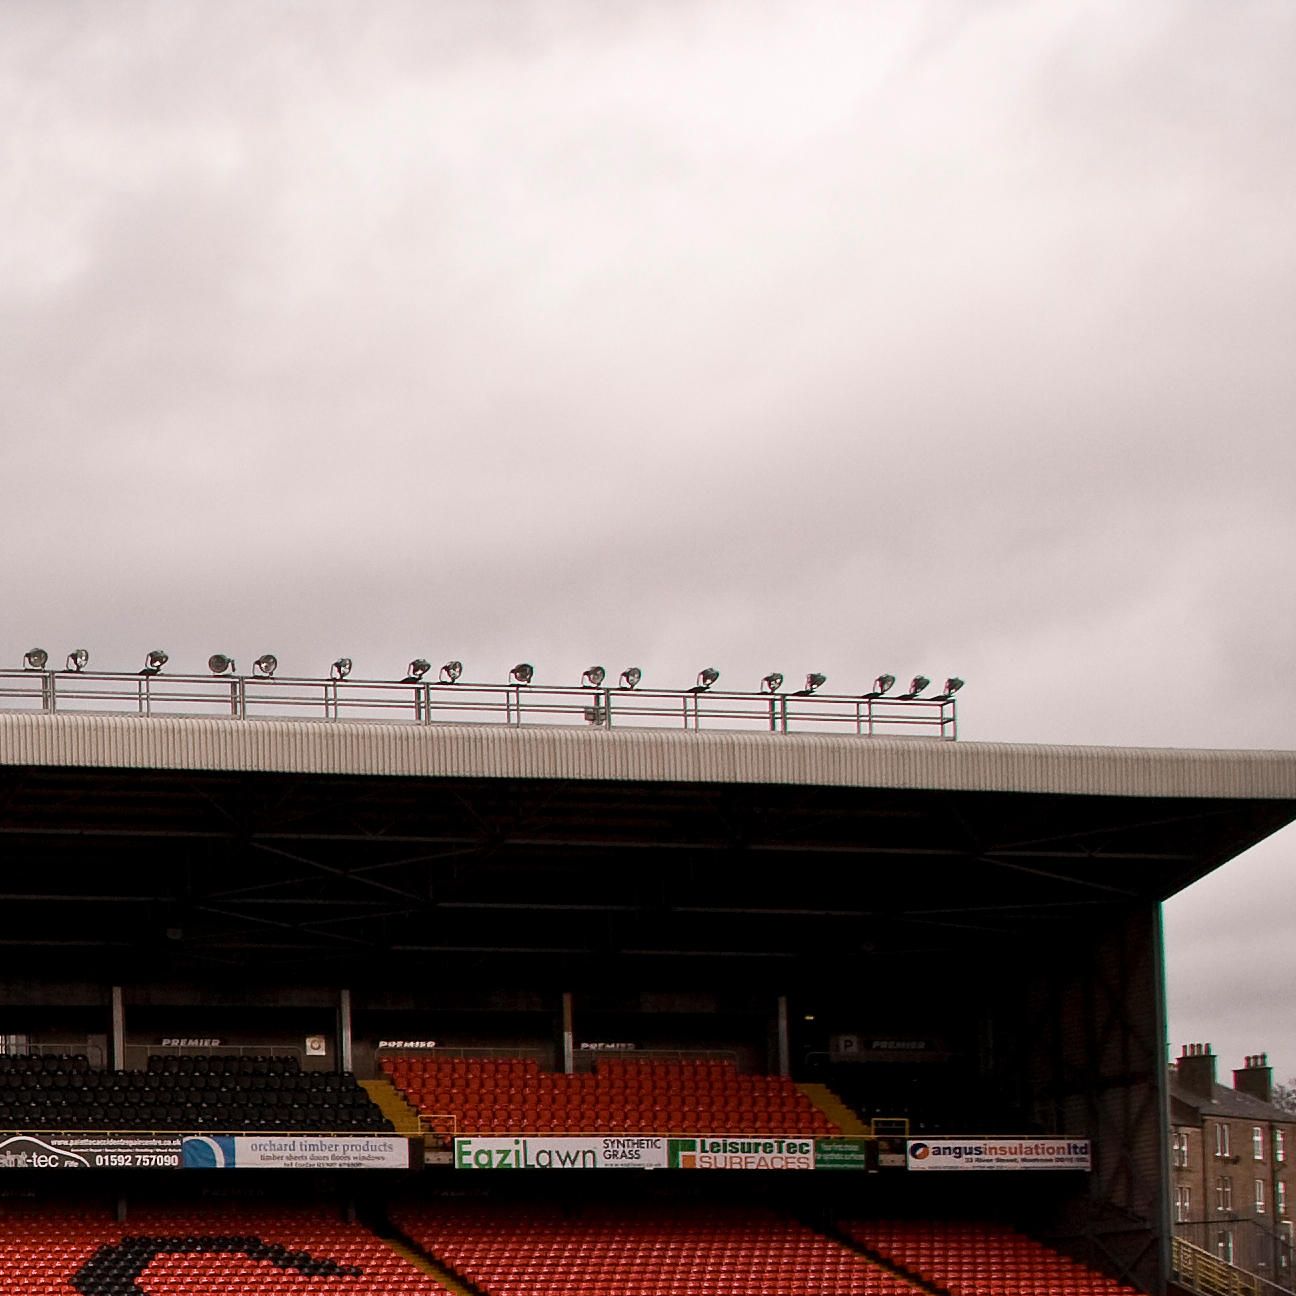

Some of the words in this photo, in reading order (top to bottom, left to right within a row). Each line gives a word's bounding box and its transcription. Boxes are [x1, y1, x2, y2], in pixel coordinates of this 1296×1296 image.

[162, 1038, 220, 1047] PREMIER
[843, 1039, 853, 1050] P
[250, 1140, 296, 1152] orchard
[299, 1140, 339, 1152] timber
[342, 1140, 394, 1155] products
[603, 1139, 661, 1149] SYNTHETIC
[700, 1139, 811, 1155] LeisureTec
[95, 1154, 132, 1166] 01592
[135, 1154, 179, 1166] 757090
[456, 1139, 598, 1169] EaziLawn
[603, 1150, 641, 1160] GRASS
[699, 1156, 810, 1169] SURFACES
